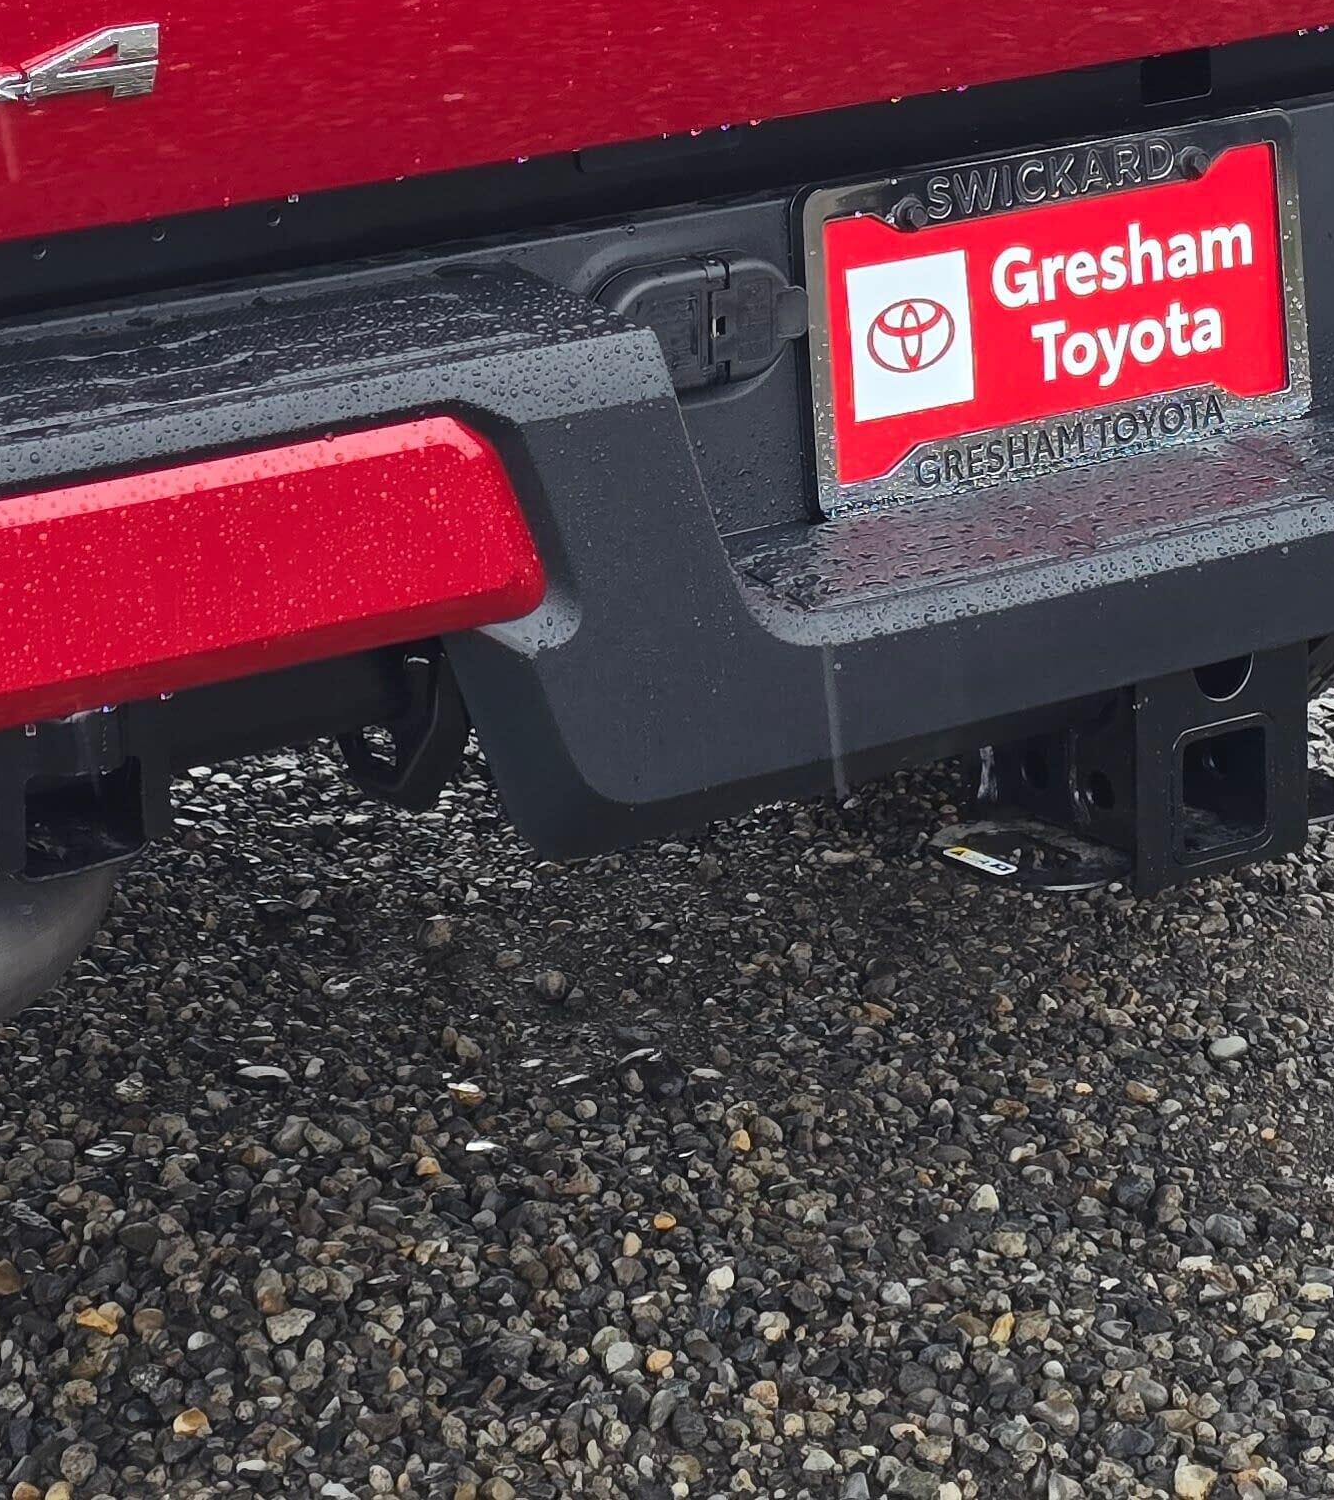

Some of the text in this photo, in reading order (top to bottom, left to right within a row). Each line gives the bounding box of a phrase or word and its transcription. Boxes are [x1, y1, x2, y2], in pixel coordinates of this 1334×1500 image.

[925, 137, 1175, 221] SWICKARD
[991, 221, 1253, 309] Gresham
[1031, 301, 1223, 389] Toyota
[914, 395, 1226, 490] GRESHAM TOYOTA
